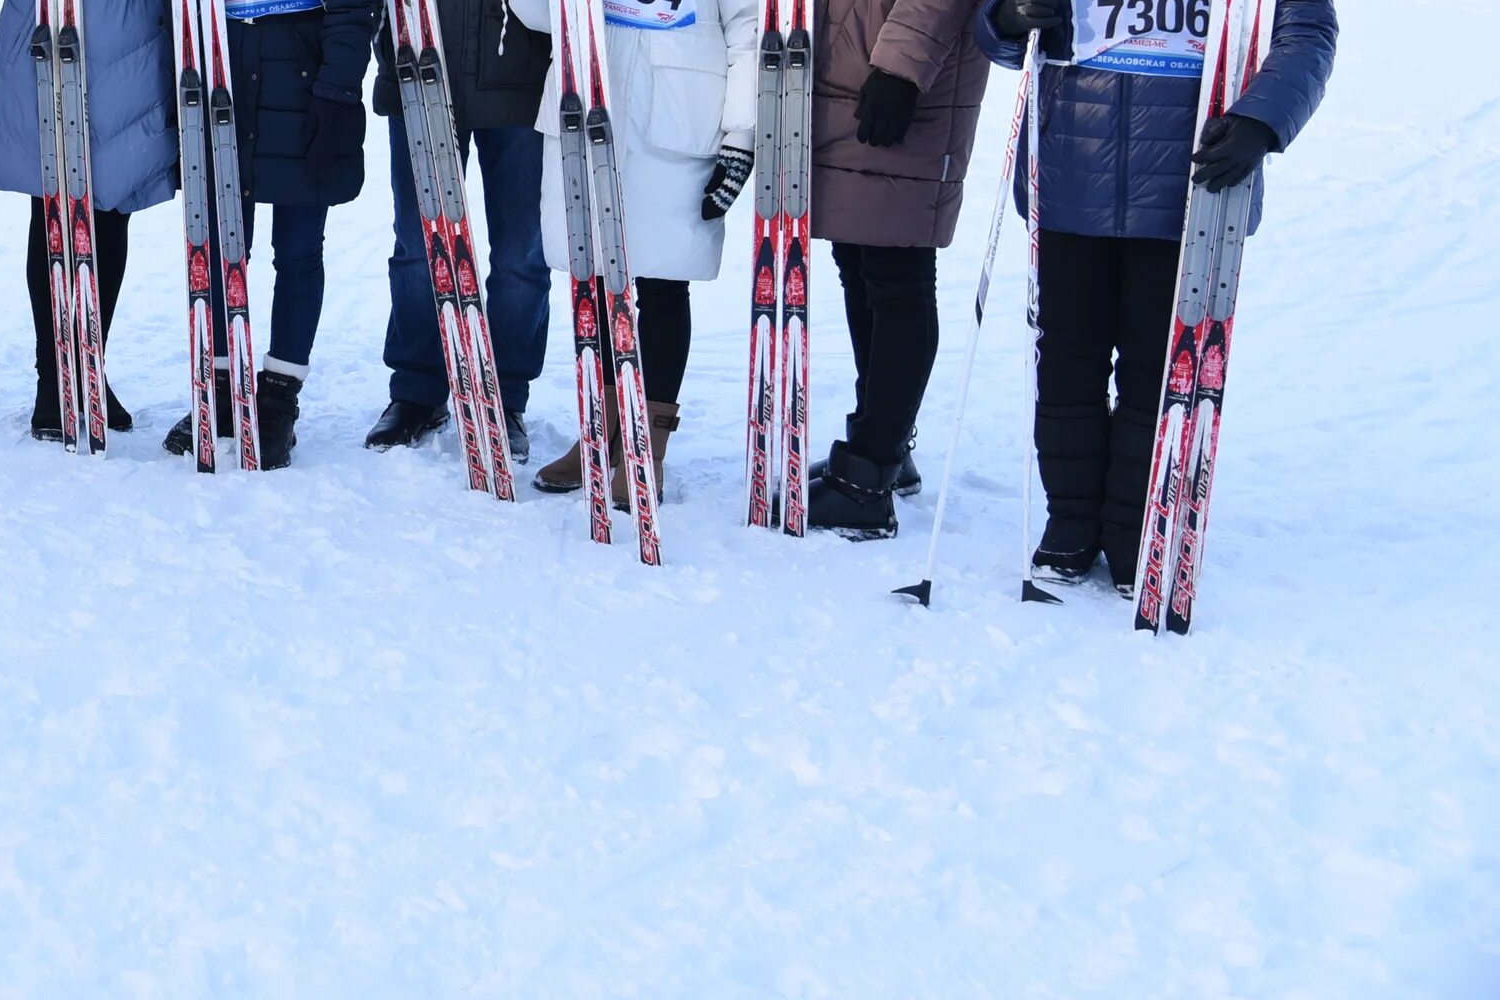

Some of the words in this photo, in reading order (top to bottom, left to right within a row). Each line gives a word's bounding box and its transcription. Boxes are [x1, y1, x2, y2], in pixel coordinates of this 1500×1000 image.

[269, 2, 304, 12] ОБЛАСТЬ
[1170, 61, 1202, 69] ОБЛАС
[750, 408, 771, 527] sport
[763, 379, 774, 422] wax
[782, 406, 806, 534] sport
[796, 382, 806, 424] wax
[1141, 487, 1169, 625] sport
[1167, 456, 1180, 505] wax
[1171, 478, 1200, 620] sport
[1199, 451, 1212, 499] wax
